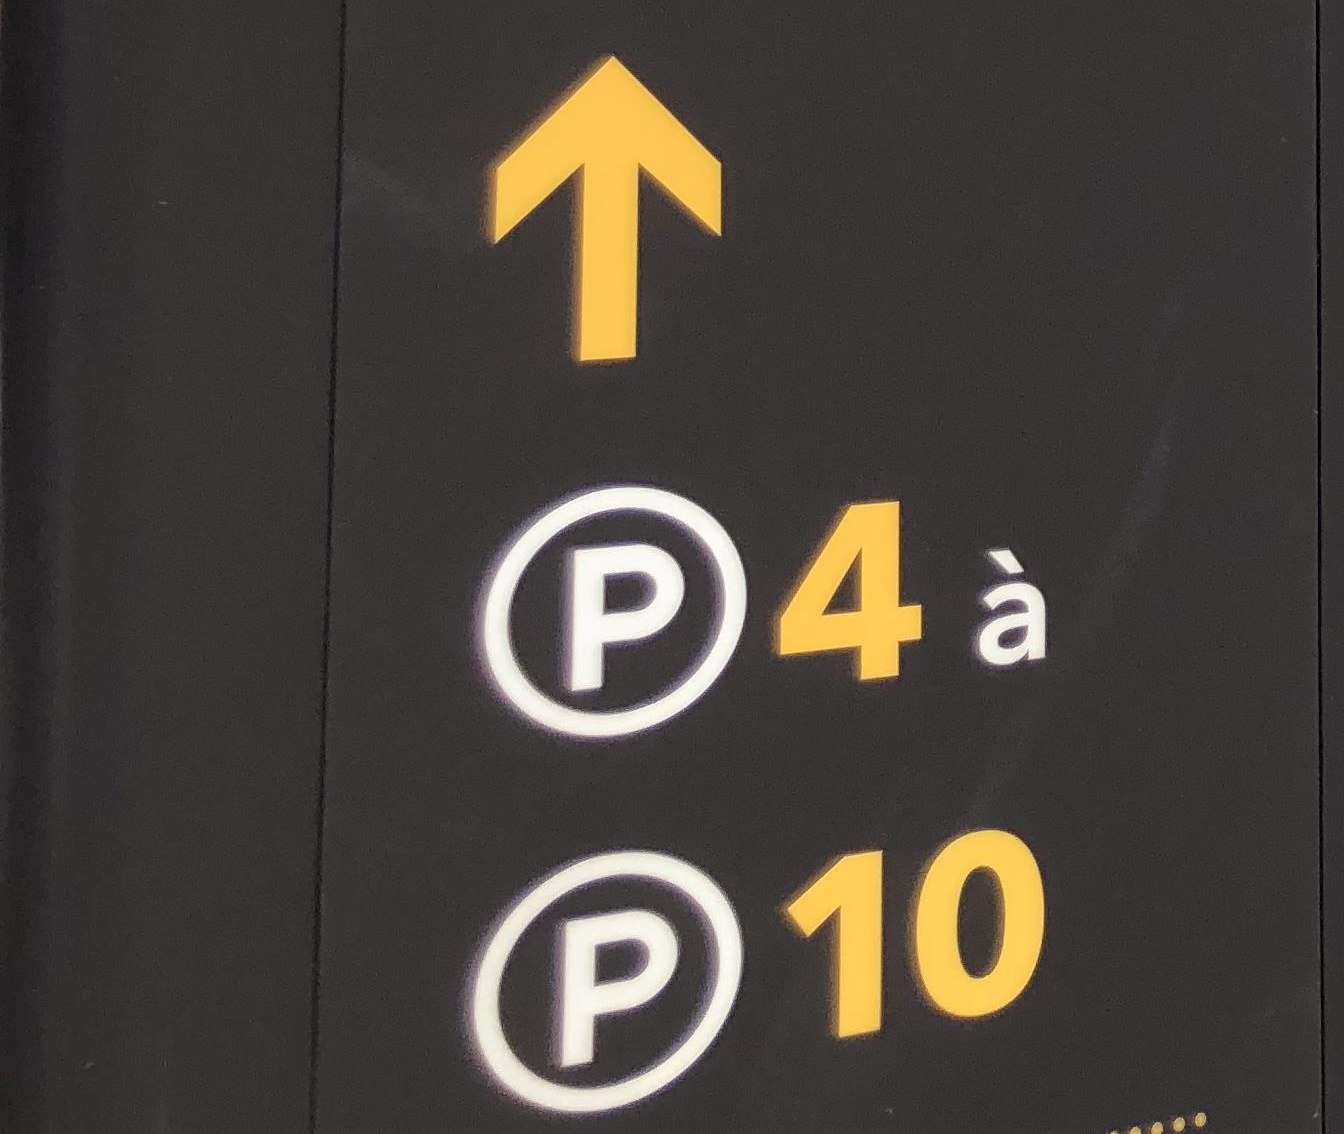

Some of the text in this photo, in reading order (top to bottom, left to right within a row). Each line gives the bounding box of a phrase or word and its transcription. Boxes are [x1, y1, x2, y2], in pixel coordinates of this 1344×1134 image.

[570, 501, 1047, 693] P 4 à
[560, 829, 1046, 1068] P 10
